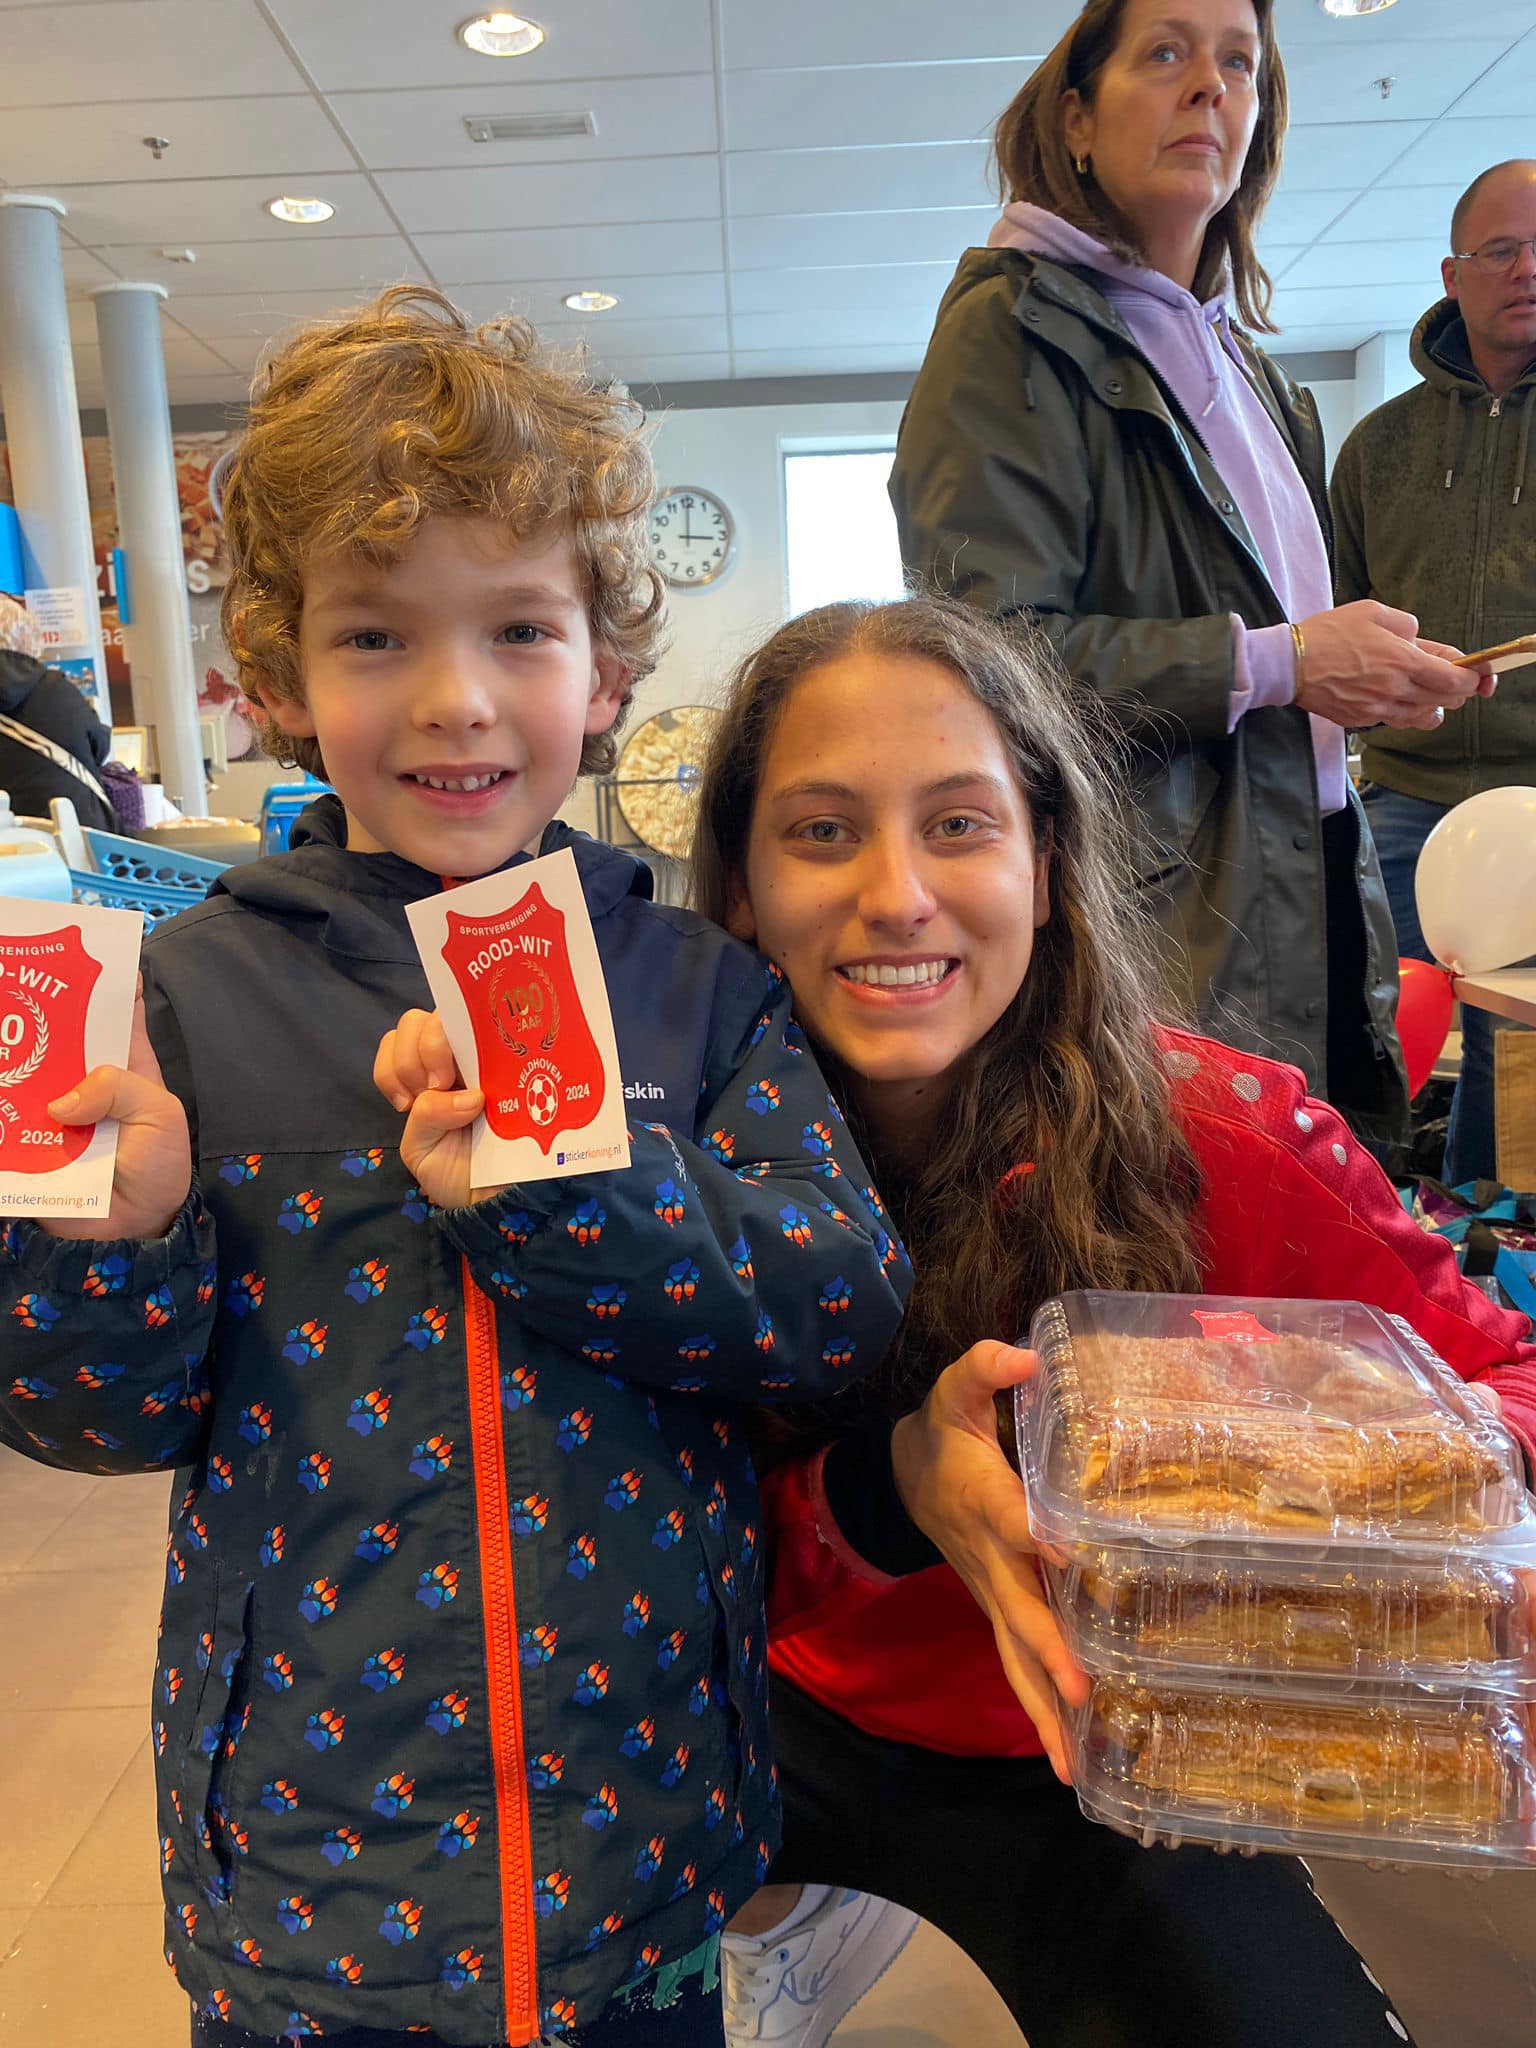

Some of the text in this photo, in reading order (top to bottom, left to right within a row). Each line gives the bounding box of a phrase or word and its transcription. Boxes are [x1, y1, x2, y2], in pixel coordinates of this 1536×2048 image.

[655, 515, 669, 527] 10
[712, 513, 722, 525] 2
[651, 533, 661, 544] 9
[718, 530, 727, 541] 3
[657, 549, 666, 560] 8
[712, 547, 722, 557] 4
[671, 562, 679, 572] 7
[686, 566, 695, 577] 6
[702, 561, 711, 572] 5
[460, 903, 538, 936] SPORTVERENIGING
[467, 935, 553, 981] ROOD-WIT
[502, 982, 544, 1018] 100
[517, 1058, 563, 1089] VELDHOVEN
[620, 1082, 665, 1100] skin
[497, 1083, 590, 1114] 1924 2024
[20, 1129, 65, 1146] 2024
[565, 1144, 622, 1163] stickerkoning.nl
[1, 1193, 98, 1209] stickerkoning.nl
